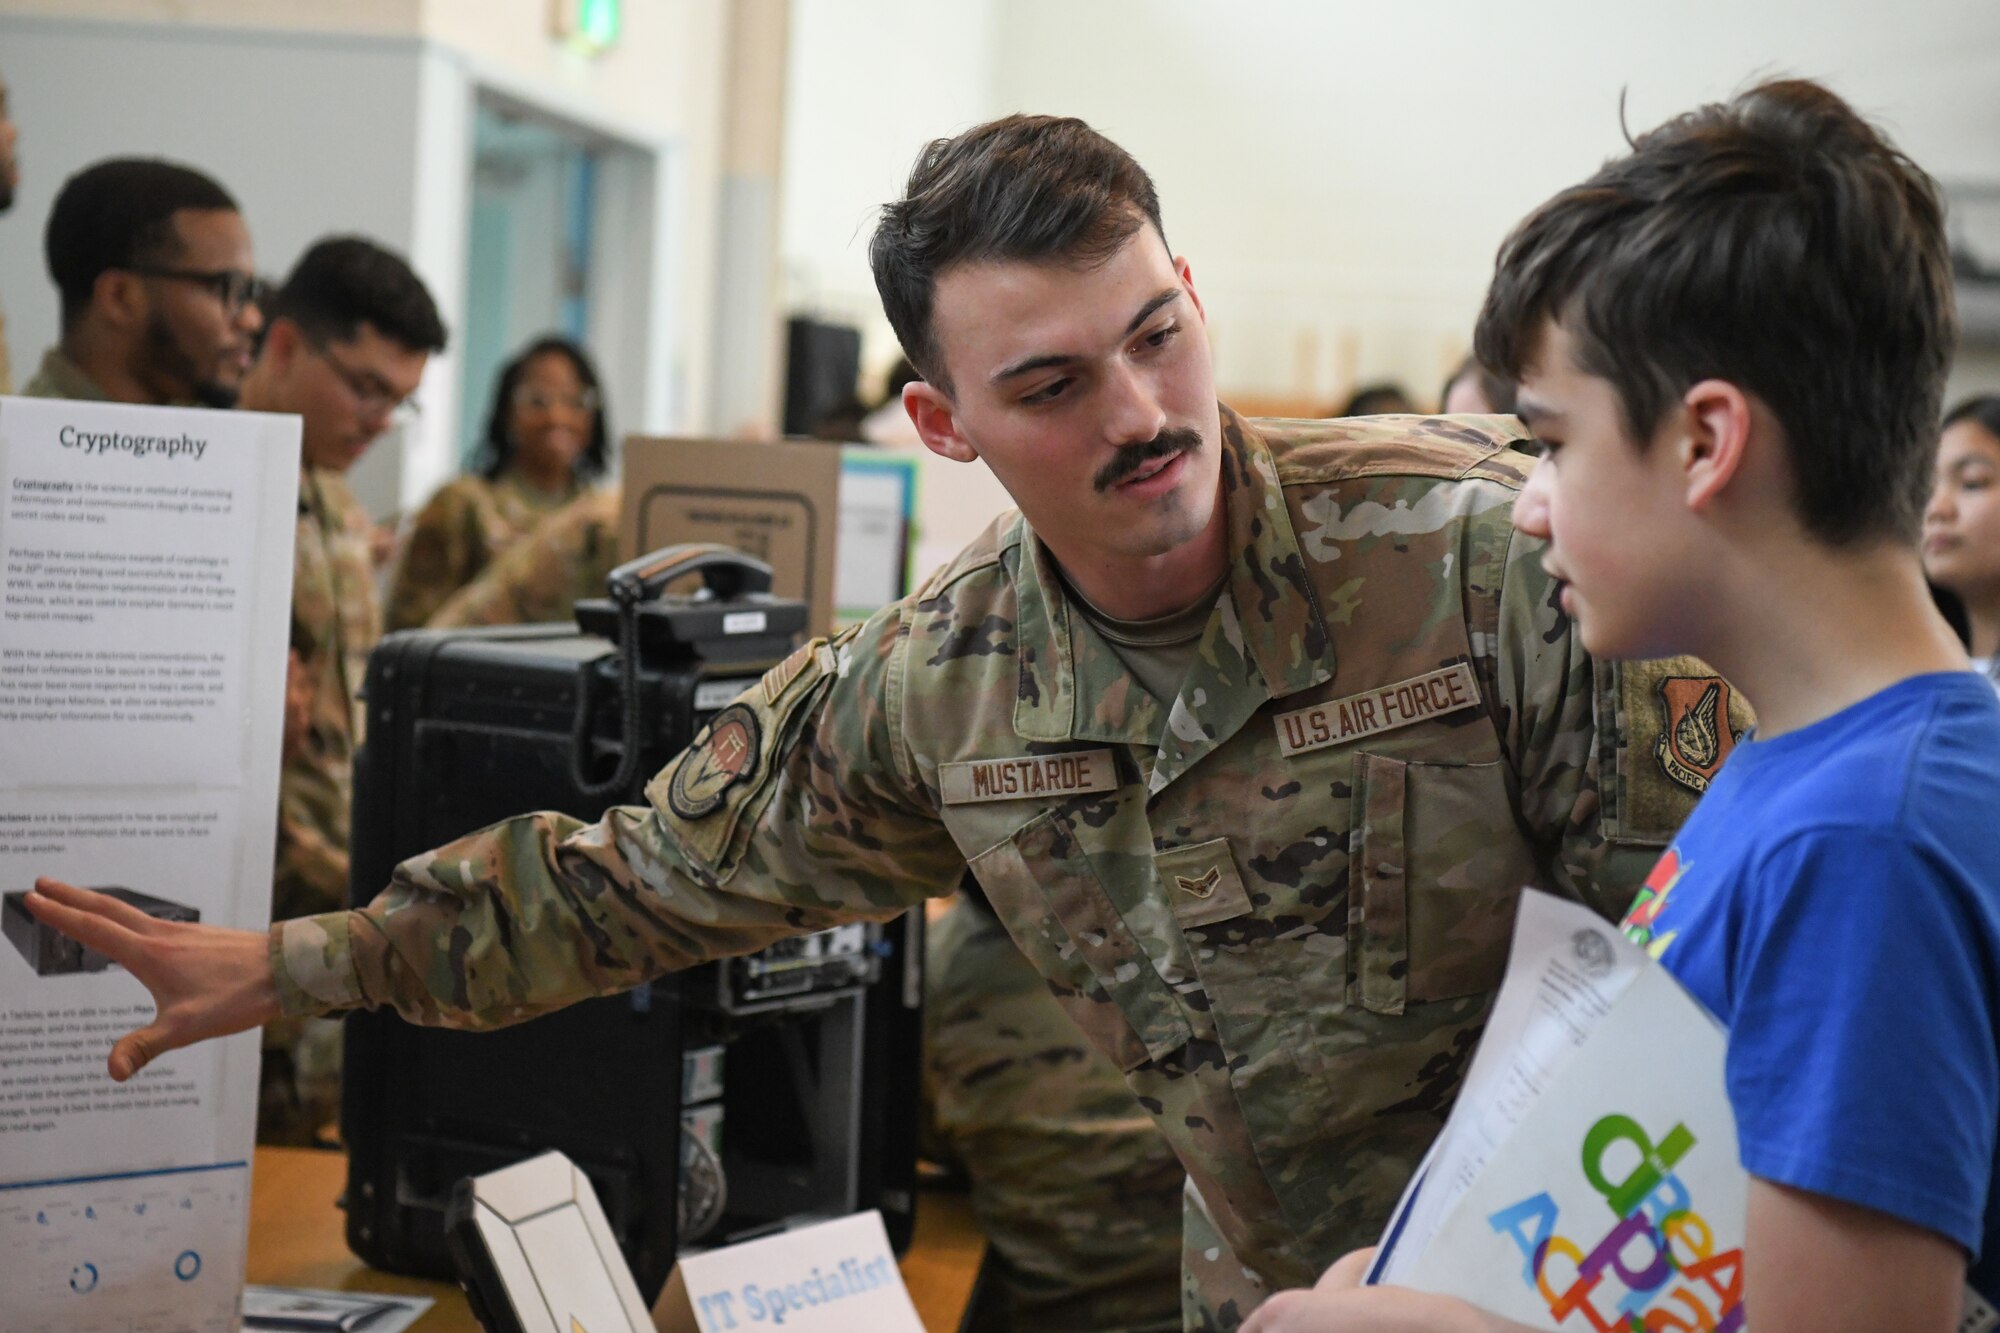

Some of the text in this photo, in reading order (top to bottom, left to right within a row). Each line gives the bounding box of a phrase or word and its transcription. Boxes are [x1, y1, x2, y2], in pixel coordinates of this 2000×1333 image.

[59, 425, 207, 459] Cryptography
[13, 477, 73, 492] Cryptography
[85, 482, 98, 491] the
[66, 497, 82, 505] and
[68, 513, 84, 521] and
[47, 549, 61, 559] the
[7, 563, 22, 572] the
[58, 581, 72, 590] the
[27, 649, 41, 658] the
[1283, 673, 1468, 749] U.S. AIR FORCE
[972, 757, 1093, 797] MUSTARDE
[1668, 759, 1701, 788] PACIFIC
[697, 1255, 894, 1333] IT Specialist
